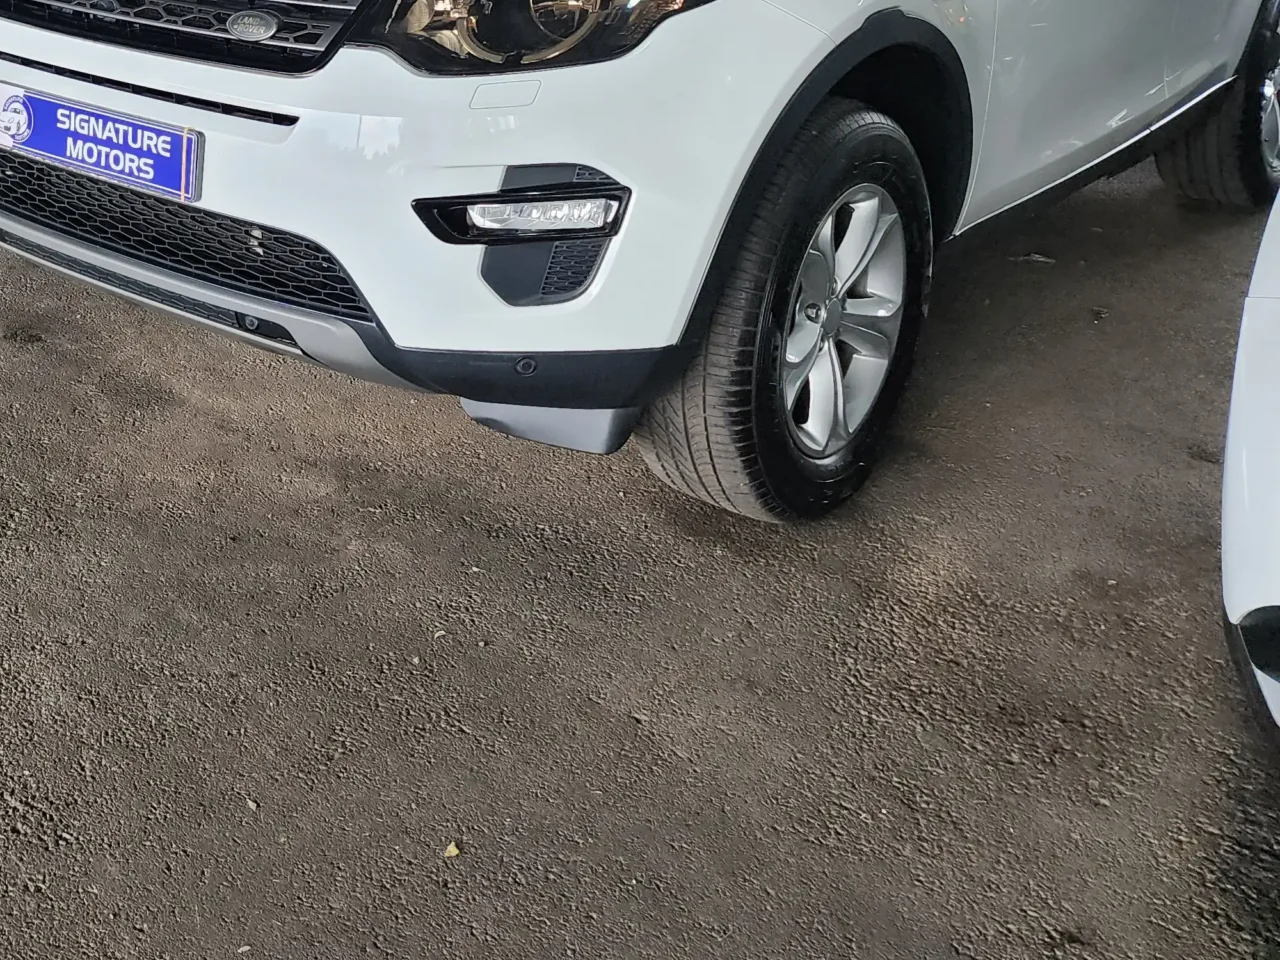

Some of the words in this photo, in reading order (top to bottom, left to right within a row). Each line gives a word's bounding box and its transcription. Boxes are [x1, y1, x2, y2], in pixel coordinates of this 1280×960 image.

[236, 23, 267, 34] ROVER
[237, 15, 261, 26] LAND
[56, 107, 172, 159] SIGNATURE
[66, 136, 155, 181] MOTORS
